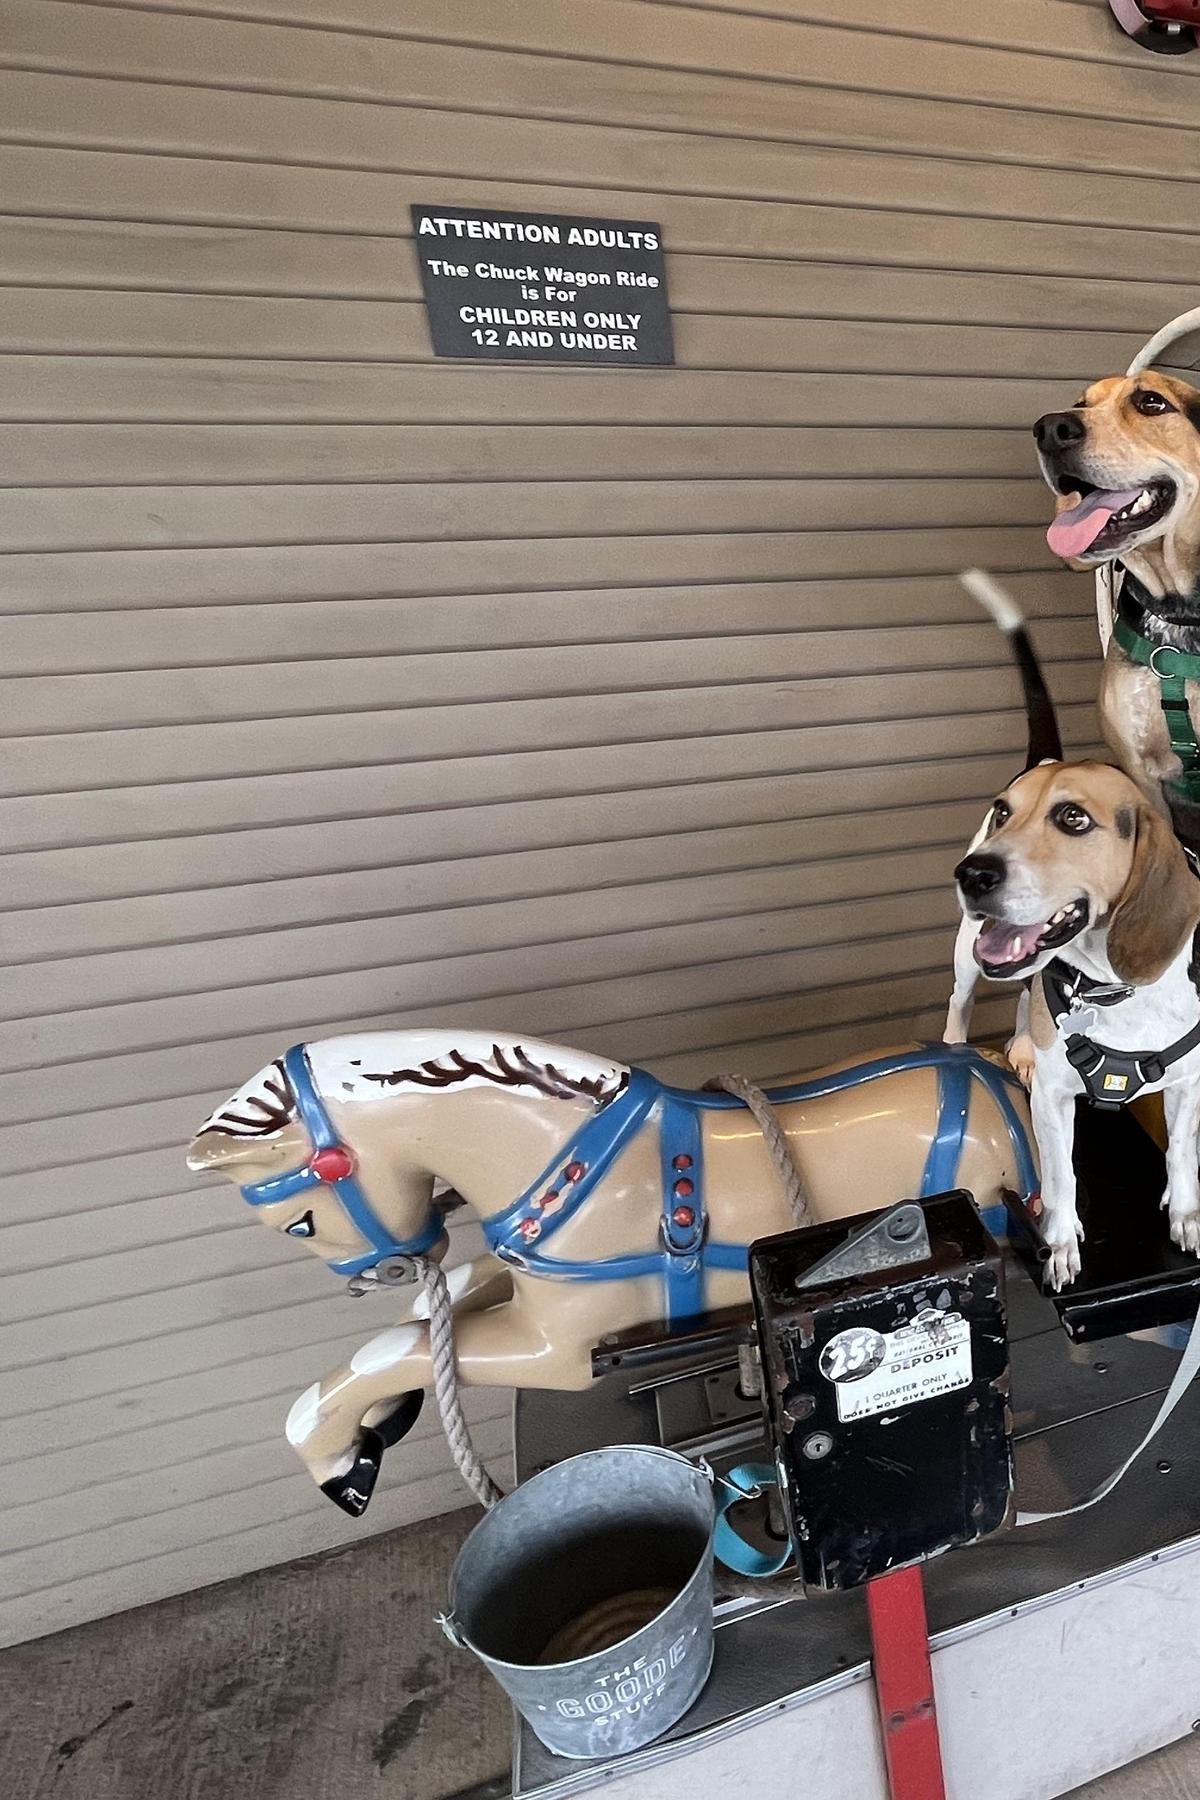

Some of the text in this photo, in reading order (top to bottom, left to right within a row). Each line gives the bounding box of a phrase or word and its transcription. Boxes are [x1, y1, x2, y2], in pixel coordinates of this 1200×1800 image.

[419, 217, 659, 250] ATTENTION ADULTS
[427, 259, 659, 288] The Chuck Wagon Ride
[521, 285, 577, 301] is For
[459, 306, 642, 330] CHILDREN ONLY
[471, 328, 638, 351] 12 AND UNDER
[890, 1346, 959, 1374] DEPOSIT
[873, 1382, 918, 1401] QUARTER
[922, 1373, 948, 1386] ONLY
[877, 1400, 897, 1409] NOT
[903, 1391, 925, 1401] GIVE
[931, 1377, 970, 1393] CHANGE
[556, 1634, 687, 1718] GOODE
[595, 1655, 648, 1687] THE
[594, 1682, 667, 1726] STUFF
